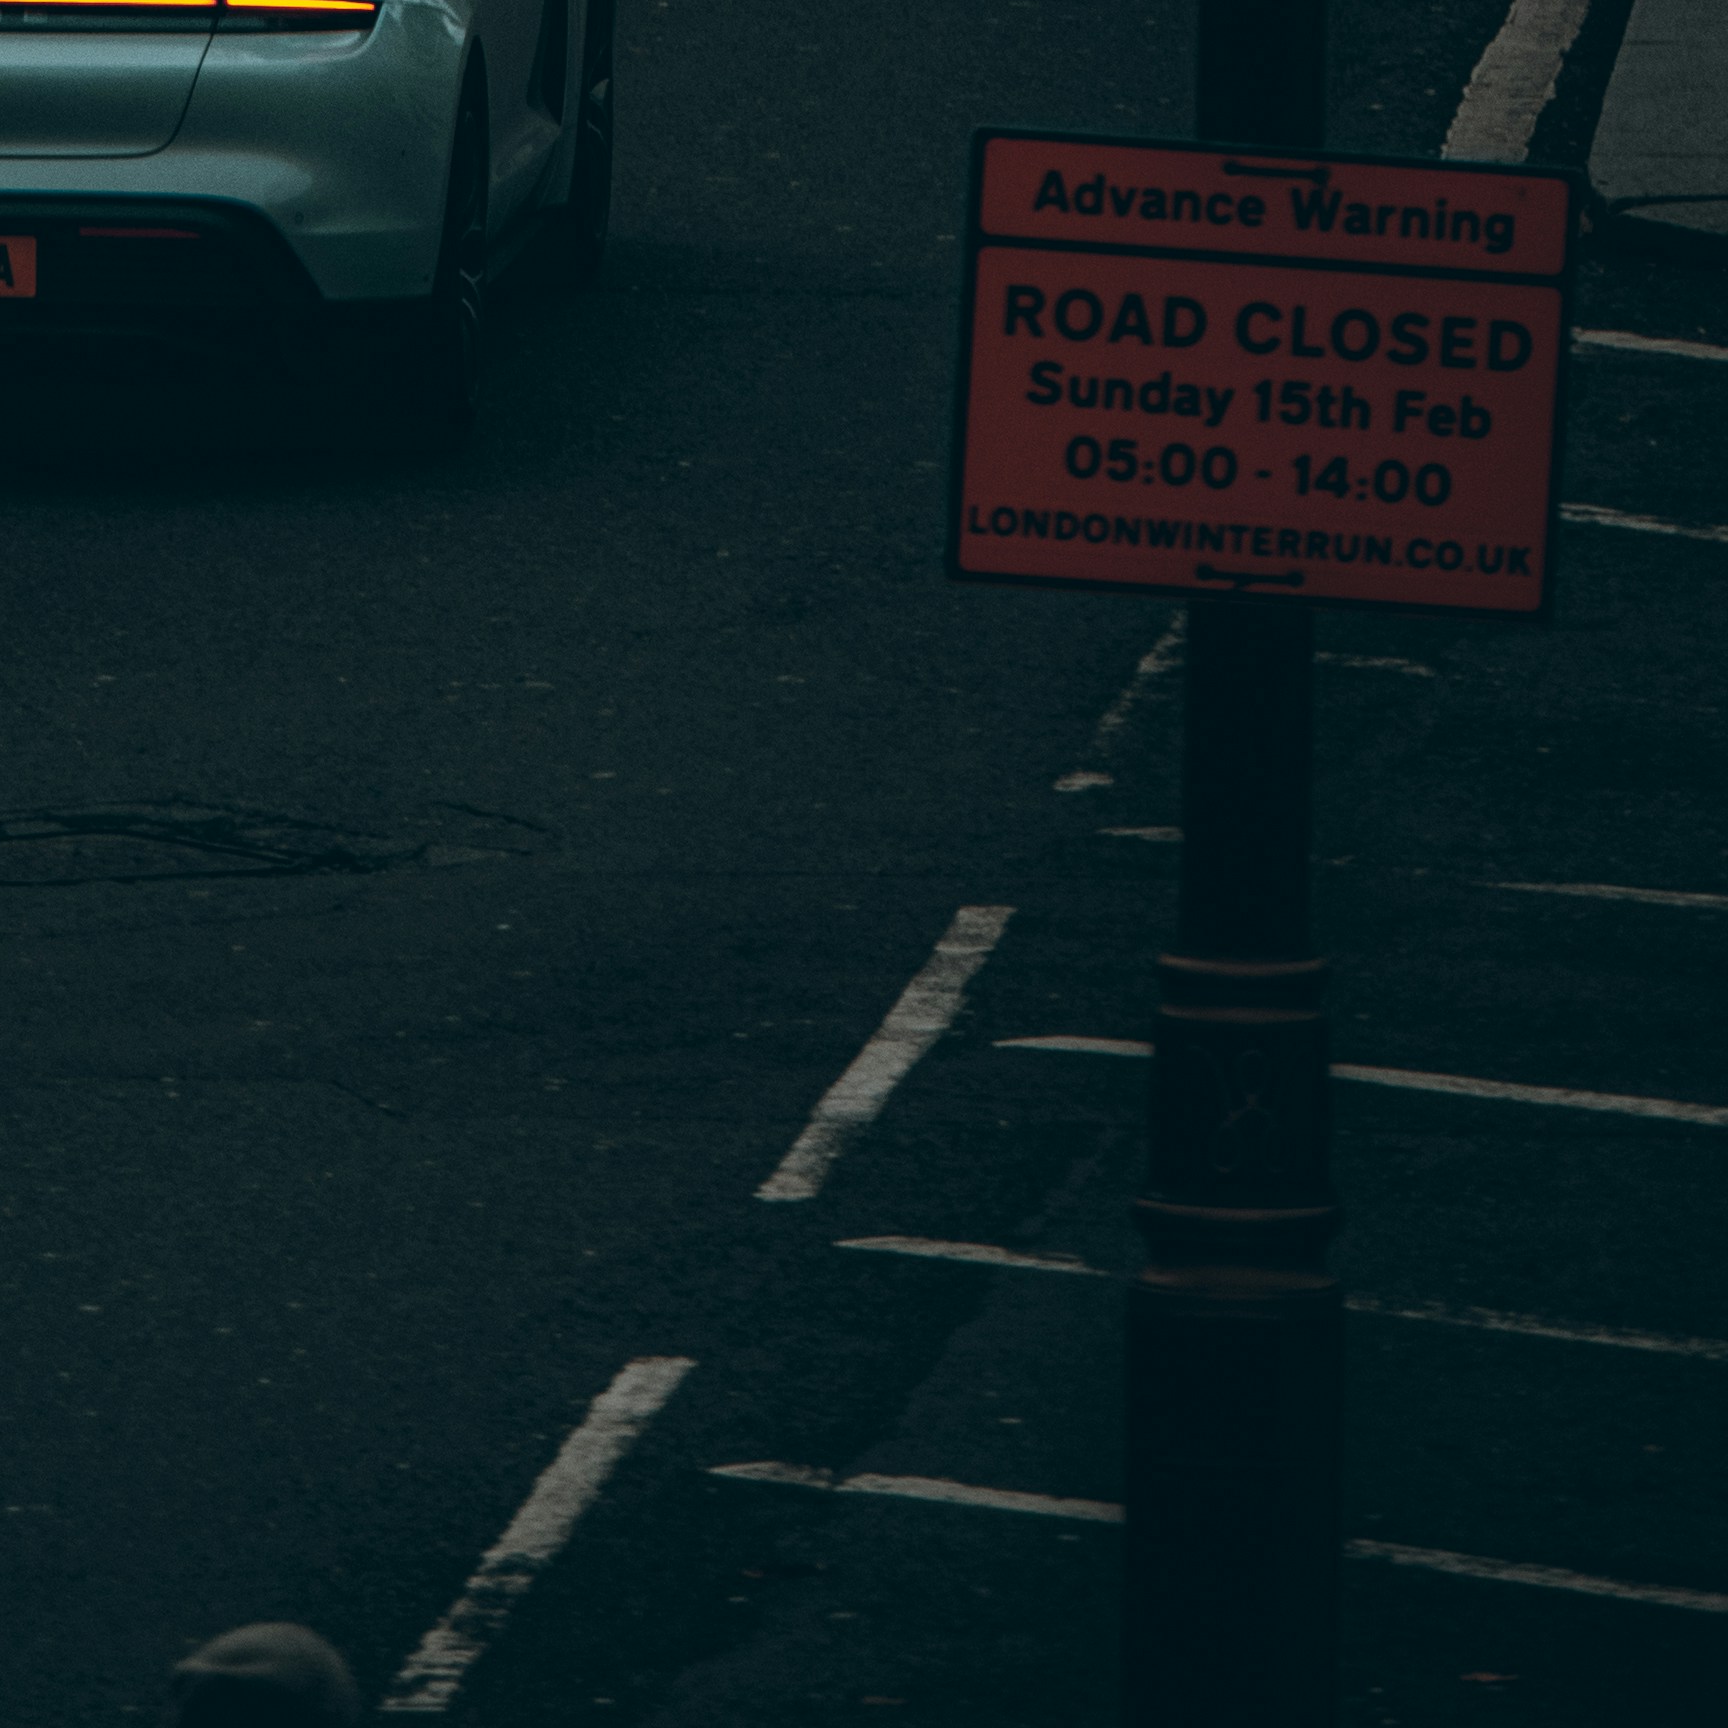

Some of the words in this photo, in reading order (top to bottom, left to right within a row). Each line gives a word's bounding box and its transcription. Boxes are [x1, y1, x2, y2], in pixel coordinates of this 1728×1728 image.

[1034, 172, 1266, 227] Advance
[1292, 189, 1515, 253] Warning
[1005, 286, 1206, 346] ROAD
[1236, 303, 1533, 372] CLOSED
[1027, 361, 1232, 426] Sunday
[1254, 381, 1370, 430] 15th
[1394, 392, 1491, 439] Feb
[1066, 436, 1237, 488] 05:00
[1295, 454, 1451, 506] 14:00
[969, 506, 1532, 577] LONDONWINTERRUN.CO.UK
